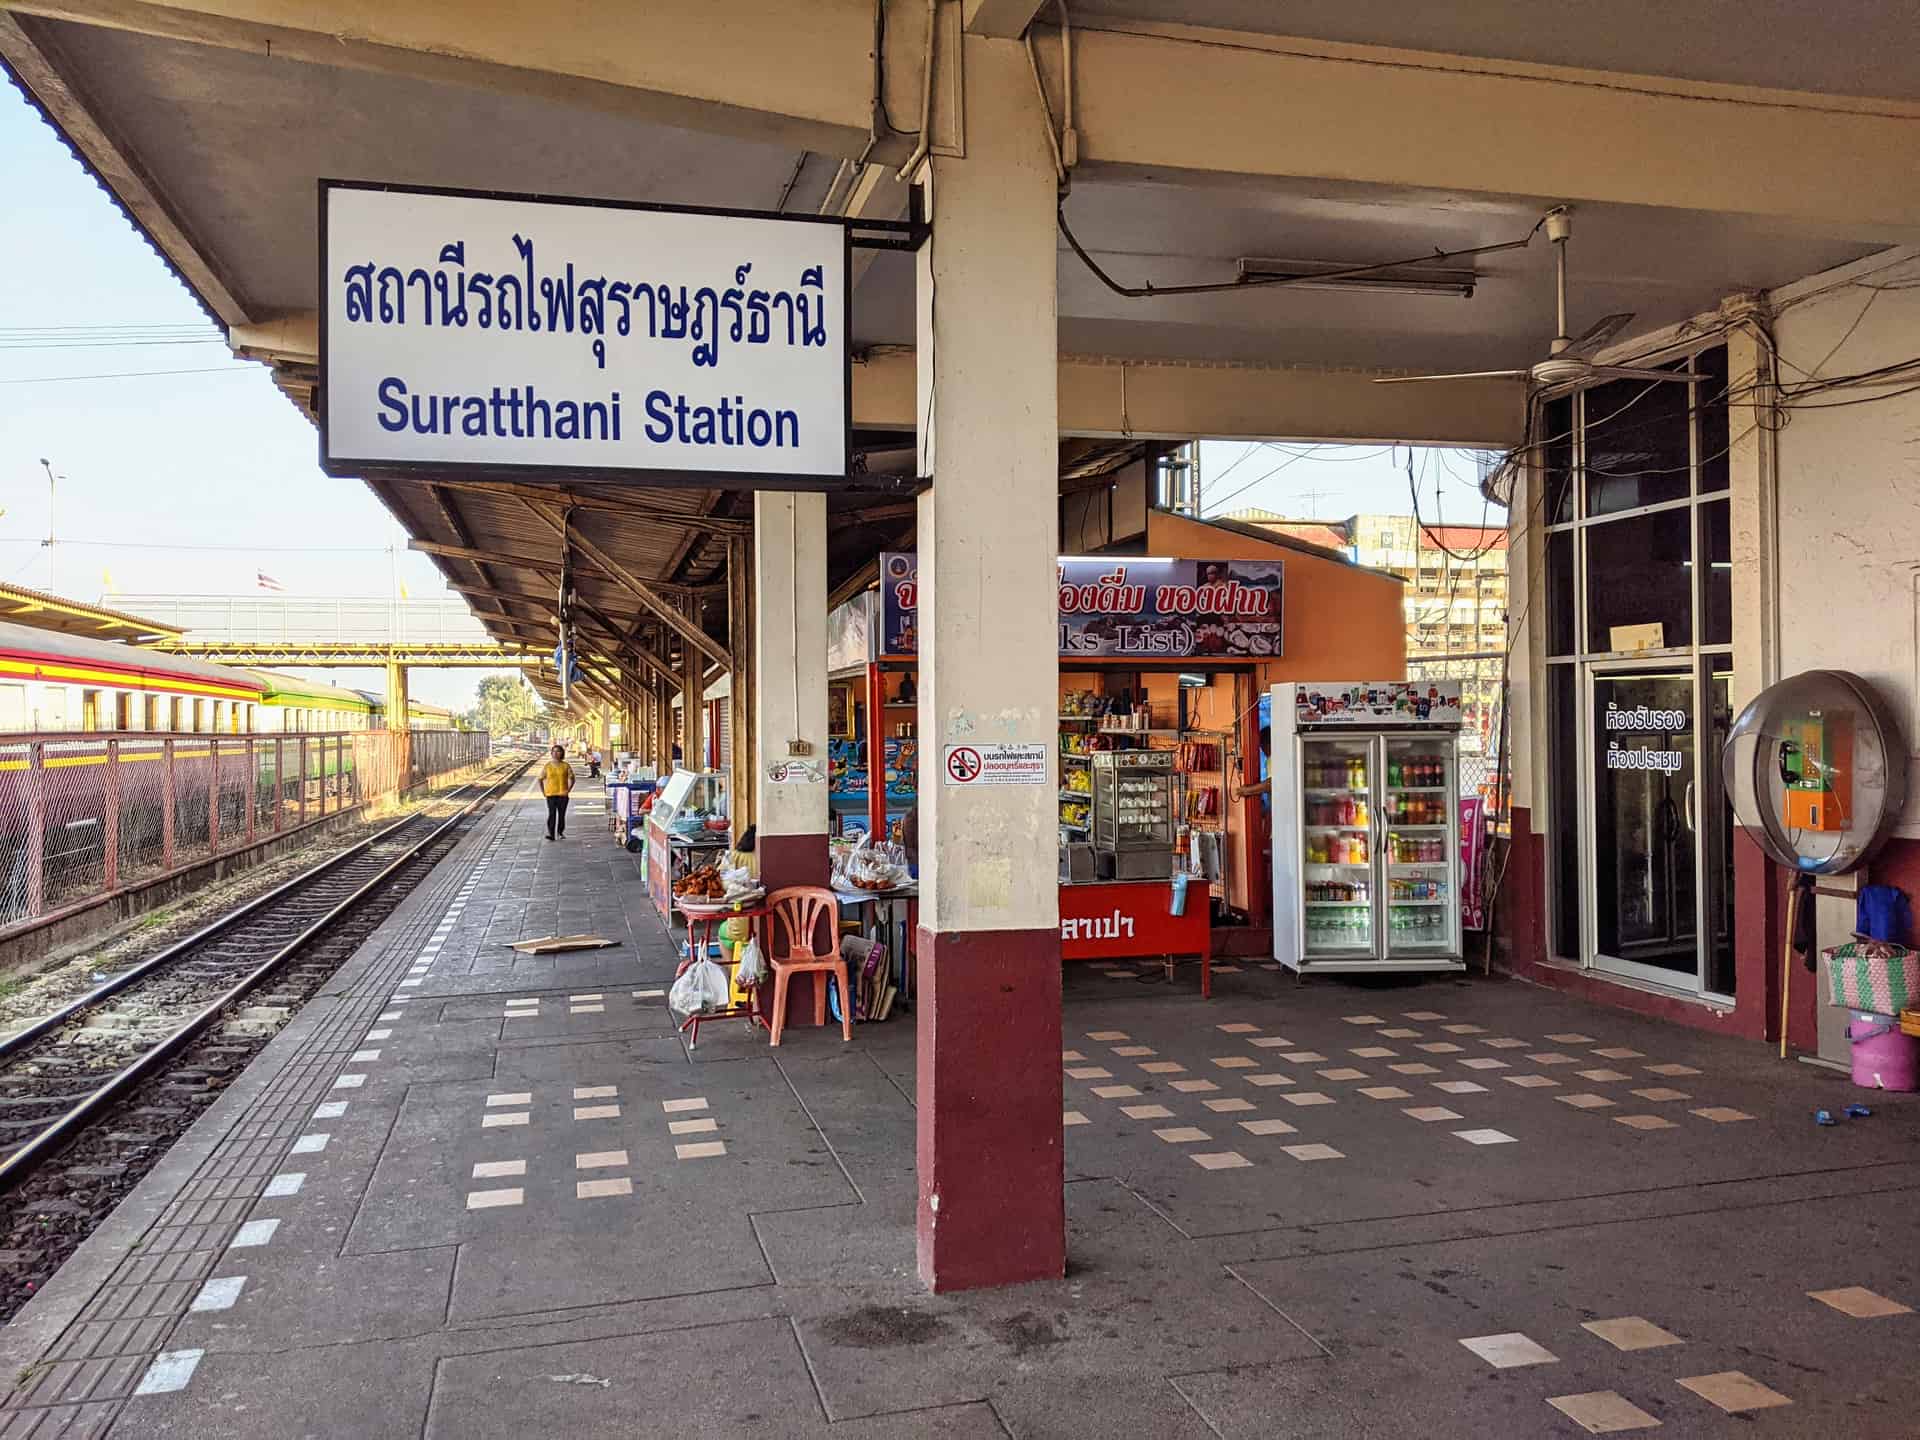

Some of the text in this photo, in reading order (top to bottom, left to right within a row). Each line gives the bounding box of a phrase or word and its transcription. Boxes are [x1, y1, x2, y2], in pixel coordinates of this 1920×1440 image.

[344, 235, 826, 369] สถานีรถไฟสุราษฎร์ธานี
[376, 377, 800, 448] Suratthani Station
[1156, 581, 1268, 614] ของฝาก
[1115, 622, 1194, 655] List)
[1606, 702, 1685, 730] ห้องรับรอง
[1607, 741, 1682, 776] ห้องประชุม
[1061, 909, 1134, 939] ลาเปา
